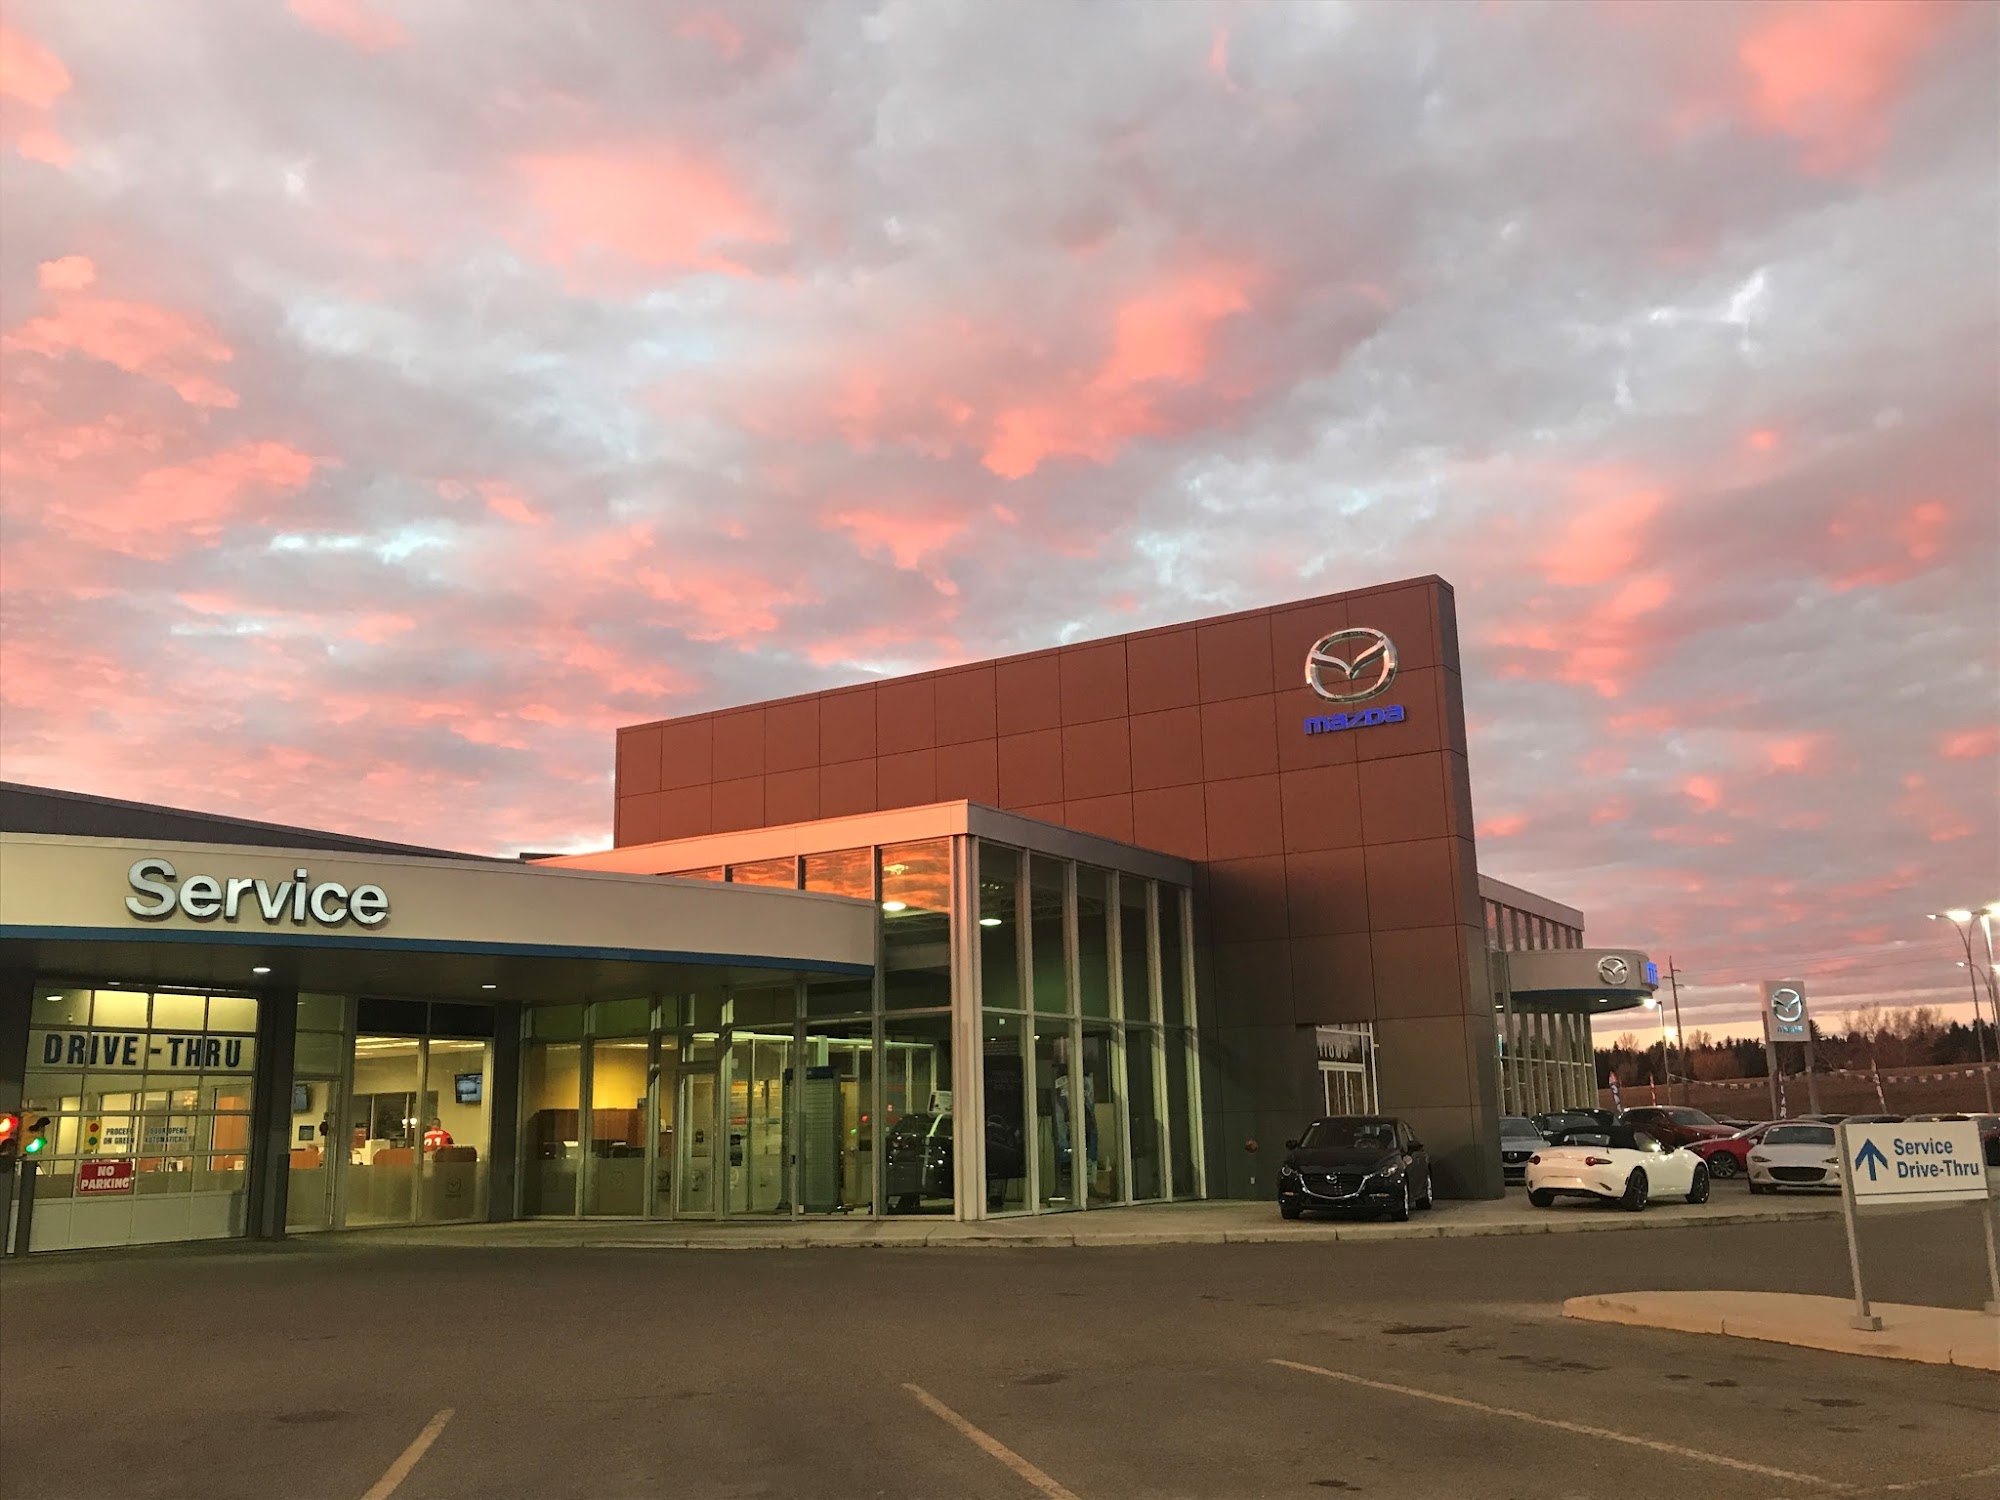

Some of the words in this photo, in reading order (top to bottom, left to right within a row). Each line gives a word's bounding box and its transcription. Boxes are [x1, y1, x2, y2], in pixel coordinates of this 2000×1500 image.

[125, 858, 389, 927] Service
[43, 1033, 241, 1068] DRIVE-THRU
[1894, 1138, 1953, 1156] Service
[97, 1166, 115, 1177] NO
[1897, 1160, 1980, 1178] Drive-Thru
[80, 1178, 130, 1190] PARKING
